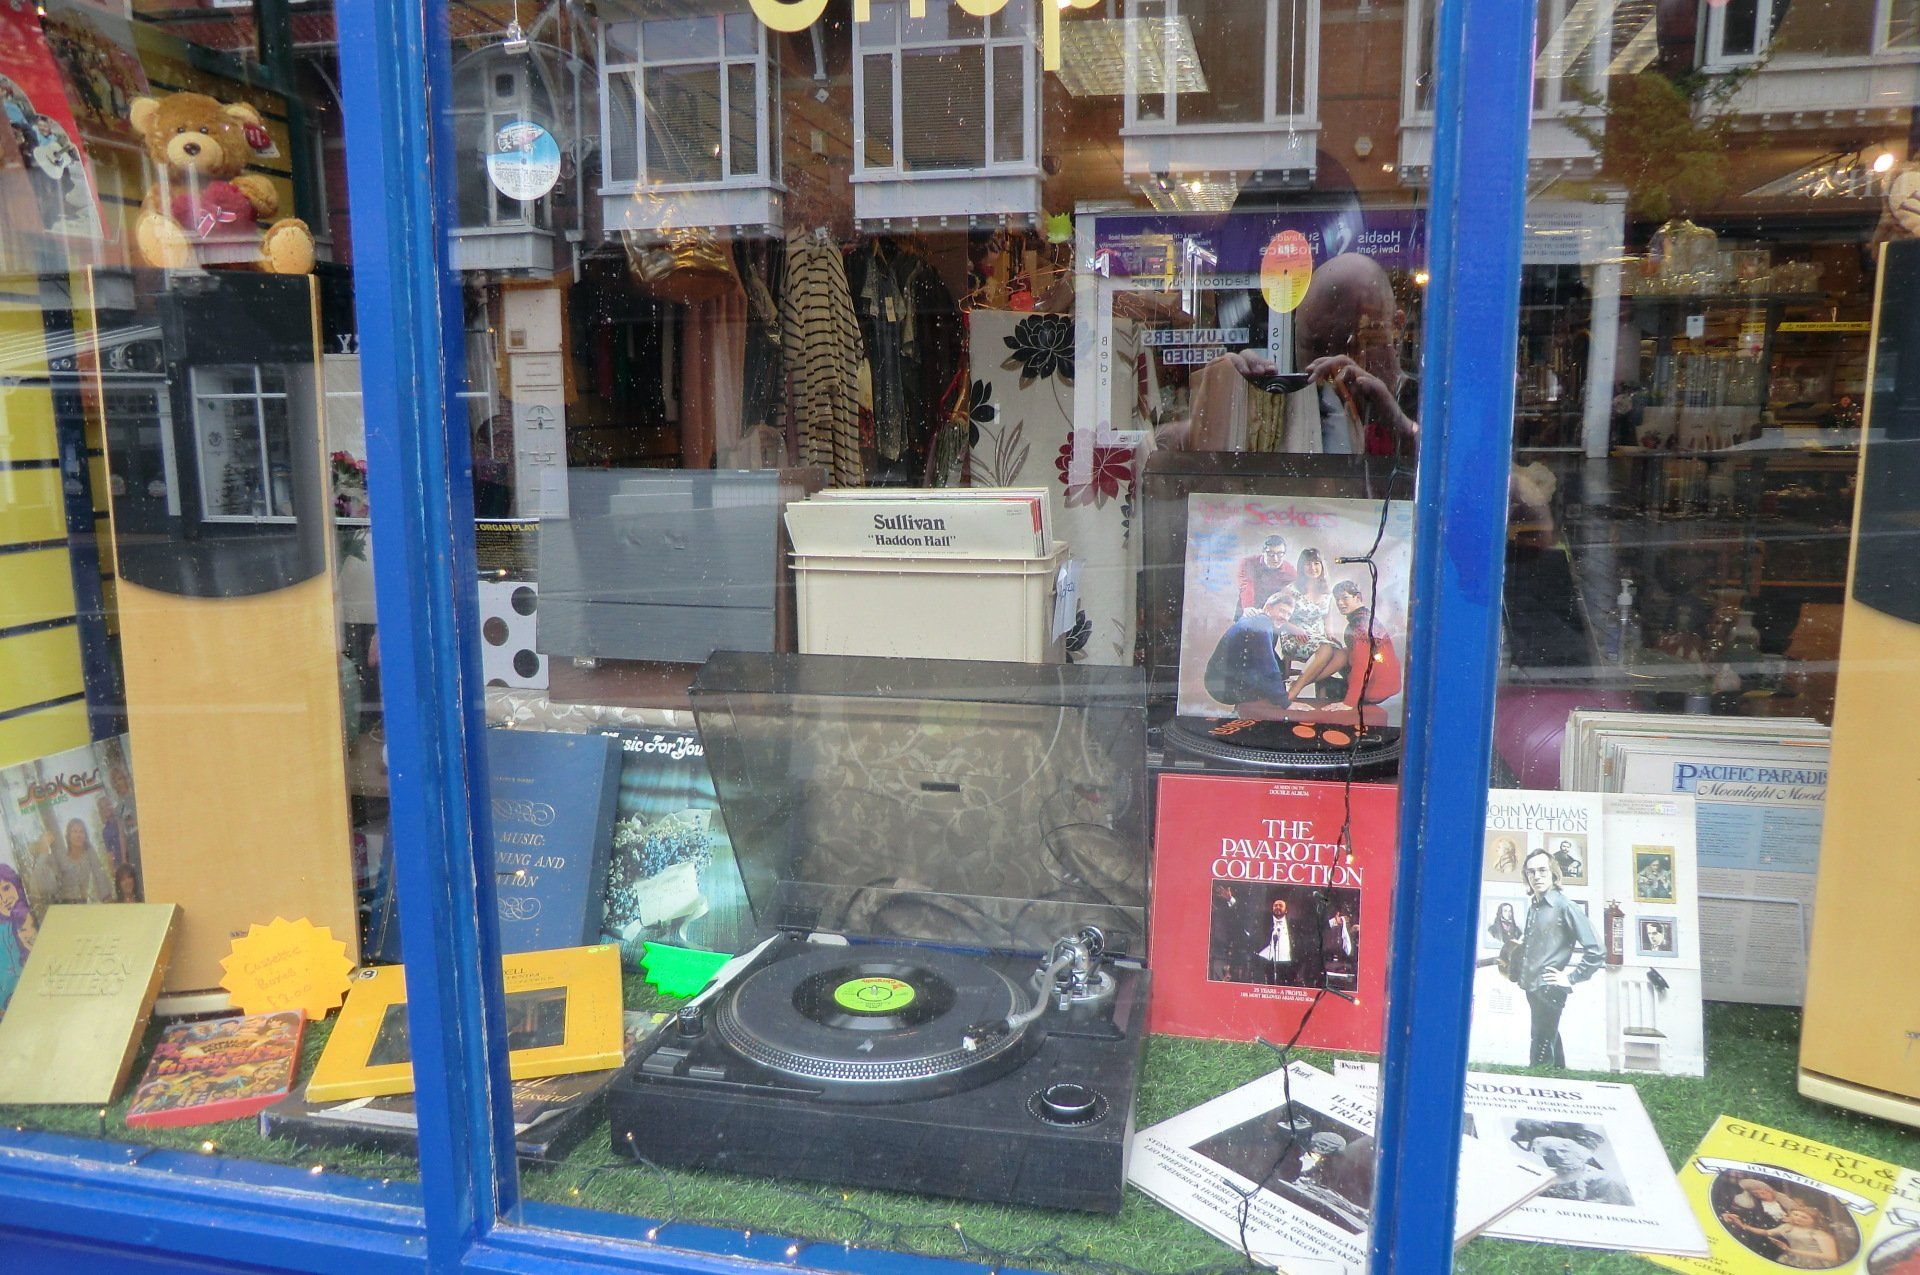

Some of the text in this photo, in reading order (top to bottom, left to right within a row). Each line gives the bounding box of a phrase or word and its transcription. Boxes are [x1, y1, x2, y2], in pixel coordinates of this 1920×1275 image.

[480, 523, 512, 532] ORGAN
[873, 513, 946, 532] Sullivan
[622, 734, 705, 760] sic For You
[1676, 763, 1754, 789] PACIFIC
[1697, 783, 1827, 802] Moonlight Mood
[1522, 803, 1588, 820] WILLIAMS
[1261, 819, 1315, 841] THE
[534, 855, 566, 870] AND
[1211, 858, 1364, 886] COLLECTION
[75, 938, 121, 956] THE
[41, 957, 132, 976] MILLION
[38, 977, 125, 997] SELLERS
[1725, 1123, 1867, 1170] GILBERT
[1874, 1168, 1897, 1182] &
[1746, 1163, 1824, 1190] IOLANTHE
[1832, 1167, 1920, 1203] DOUBL
[1554, 1209, 1605, 1221] ARTHUR
[1291, 1215, 1337, 1240] WINIFRED
[1290, 1225, 1330, 1247] GEORGE
[1327, 1245, 1362, 1264] BAKER
